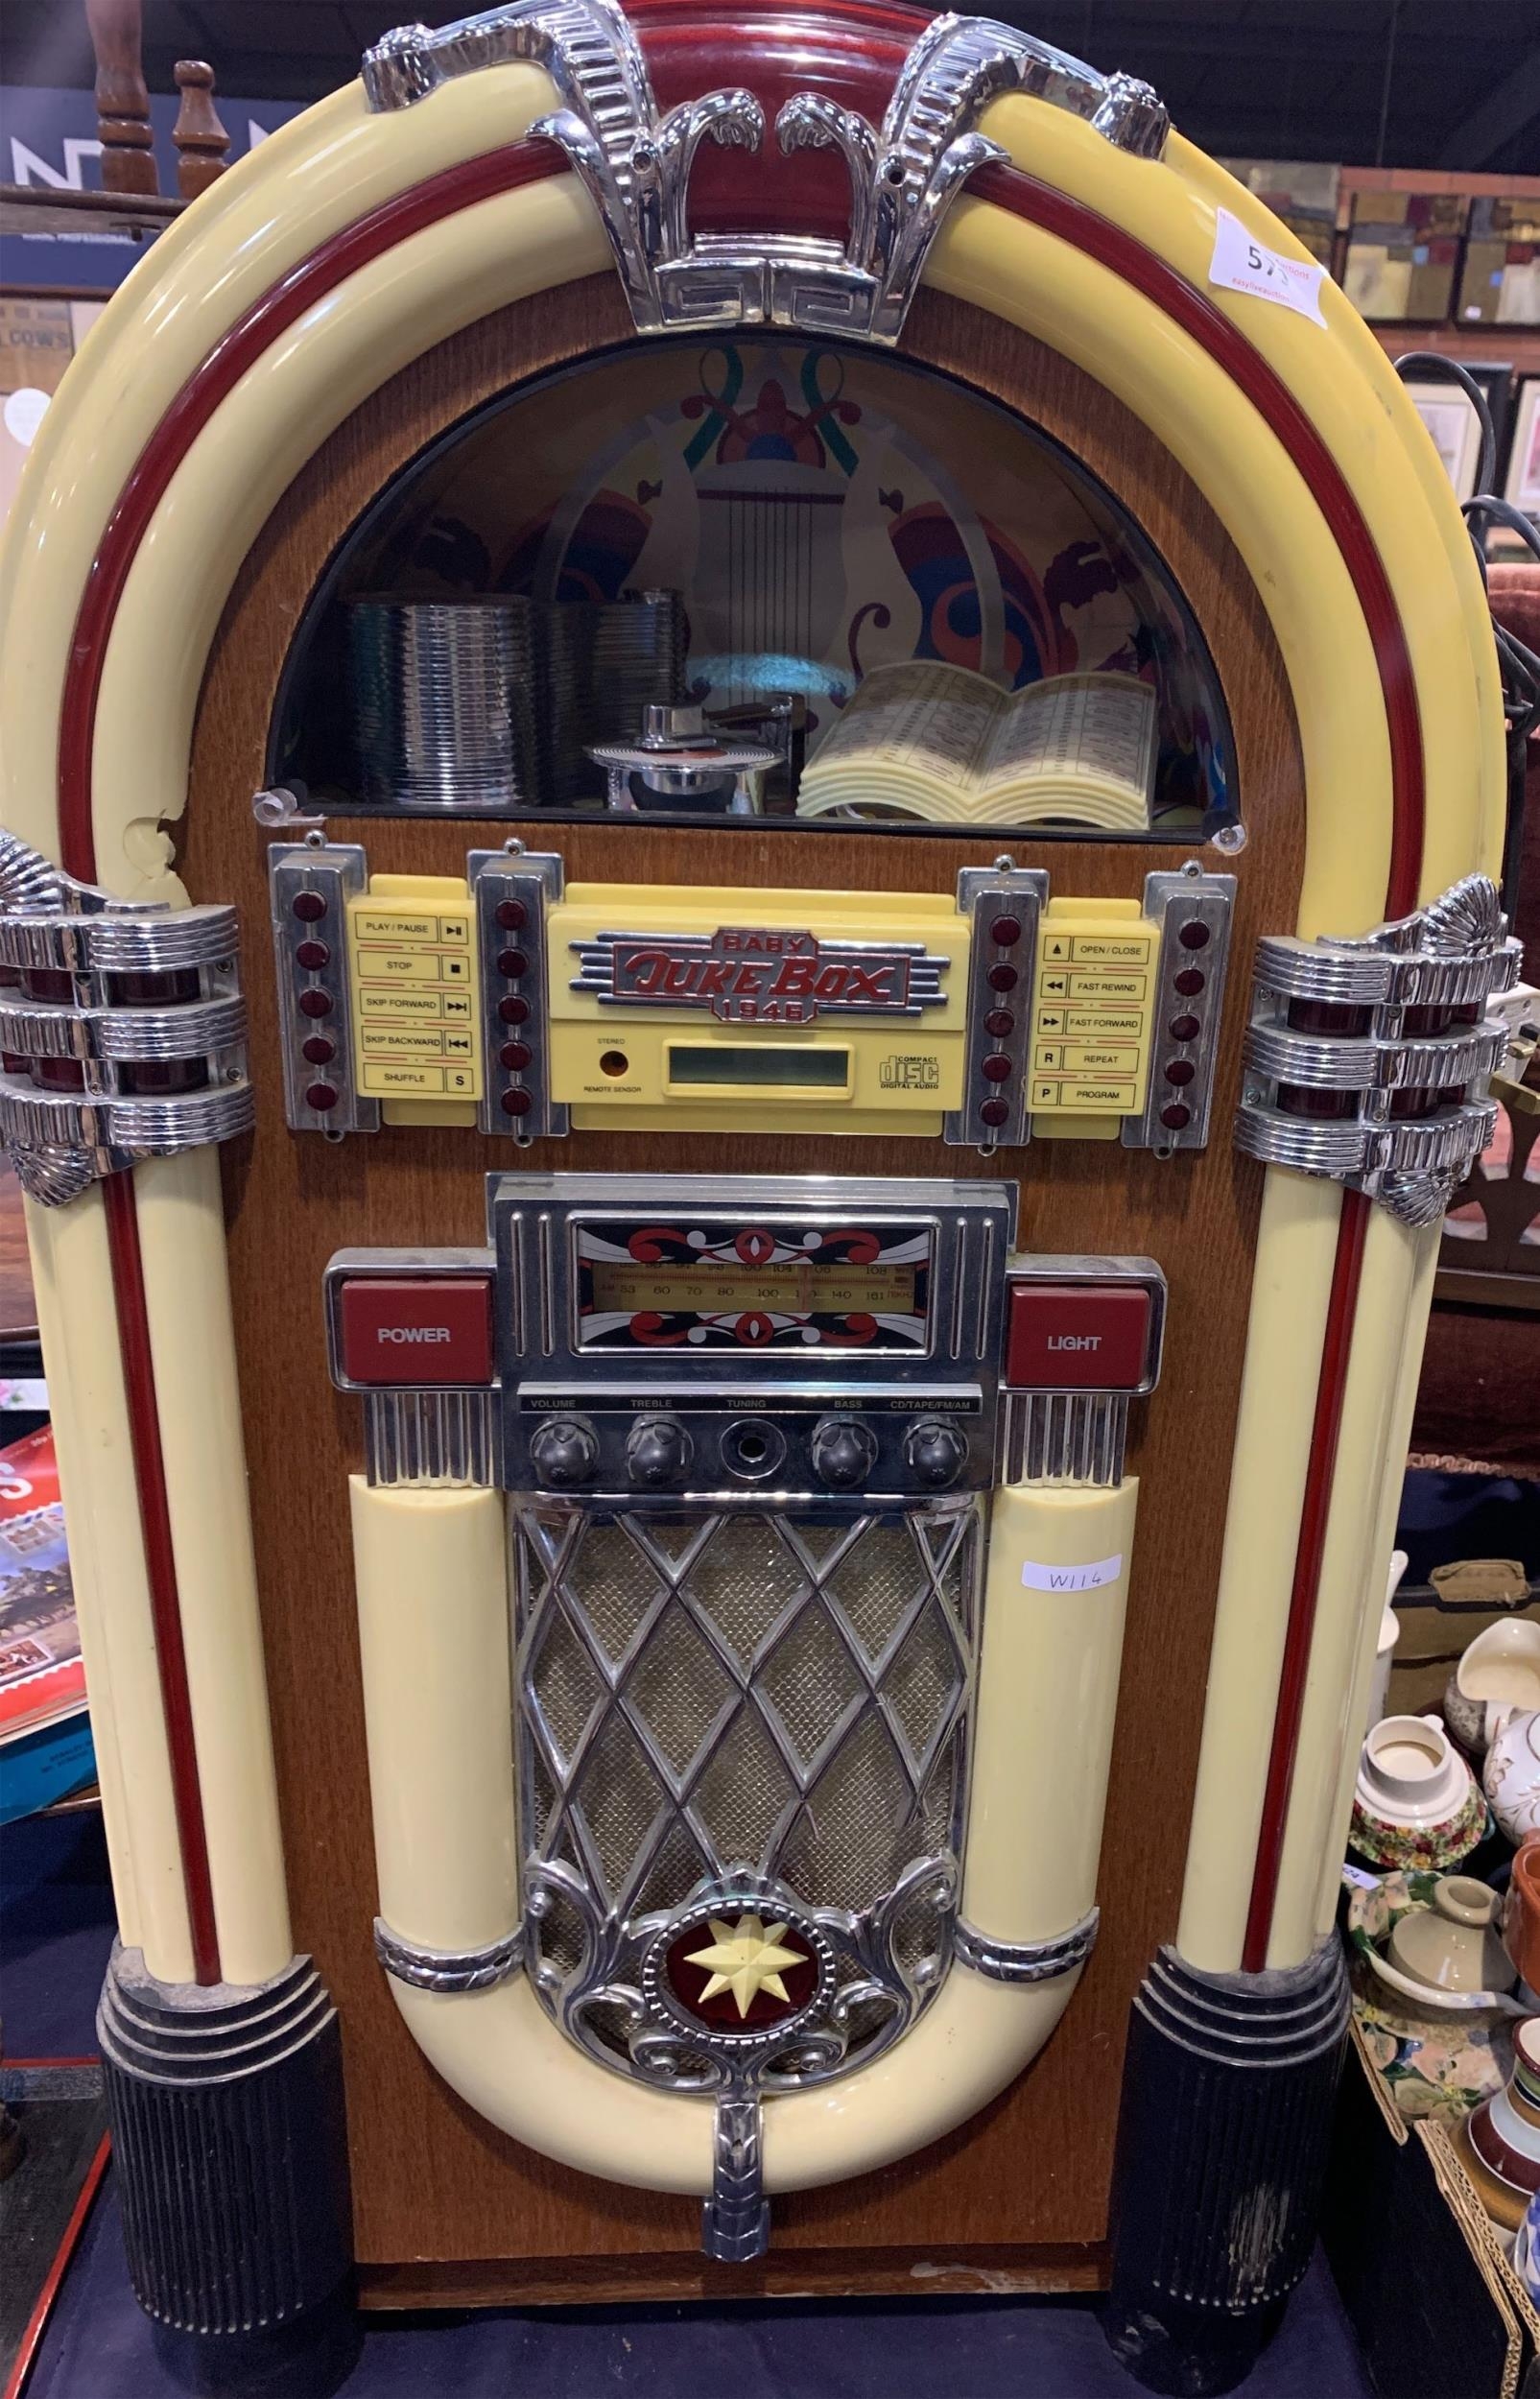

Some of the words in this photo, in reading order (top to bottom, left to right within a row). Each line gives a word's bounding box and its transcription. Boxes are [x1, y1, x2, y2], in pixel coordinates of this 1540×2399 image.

[366, 922, 390, 931] PLAY
[397, 923, 429, 933] PAUSE
[723, 935, 805, 953] BABY
[1080, 945, 1104, 954] OPEN
[1111, 946, 1142, 956] CLOSE
[387, 961, 413, 970] STOP
[768, 956, 896, 1000] BOX
[1078, 983, 1101, 991] FAST
[1102, 984, 1137, 992] REWIND
[366, 998, 388, 1007] SKIP
[390, 999, 437, 1009] FORWARD
[722, 999, 803, 1019] 1946
[1070, 1018, 1093, 1027] FAST
[1094, 1019, 1138, 1029] FORWARD
[365, 1034, 387, 1044] SKIP
[388, 1036, 440, 1047] BACKWARD
[1044, 1054, 1054, 1063] R
[1083, 1055, 1119, 1063] REPEAT
[384, 1073, 425, 1082] SHUFFLE
[455, 1076, 464, 1085] S
[1042, 1088, 1051, 1098] P
[1077, 1090, 1120, 1100] PROGRAM
[653, 1286, 671, 1295] 60
[686, 1287, 701, 1295] 70
[718, 1287, 735, 1296] 80
[758, 1288, 780, 1298] 100
[832, 1291, 852, 1299] 140
[377, 1328, 451, 1342] POWER
[1047, 1336, 1102, 1350] LIGHT
[531, 1399, 576, 1408] VOLUME
[630, 1399, 672, 1408] TREBLE
[834, 1400, 863, 1409] BASS
[890, 1400, 971, 1410] CD/TAPE/FM/AM
[1051, 1572, 1102, 1589] W114
